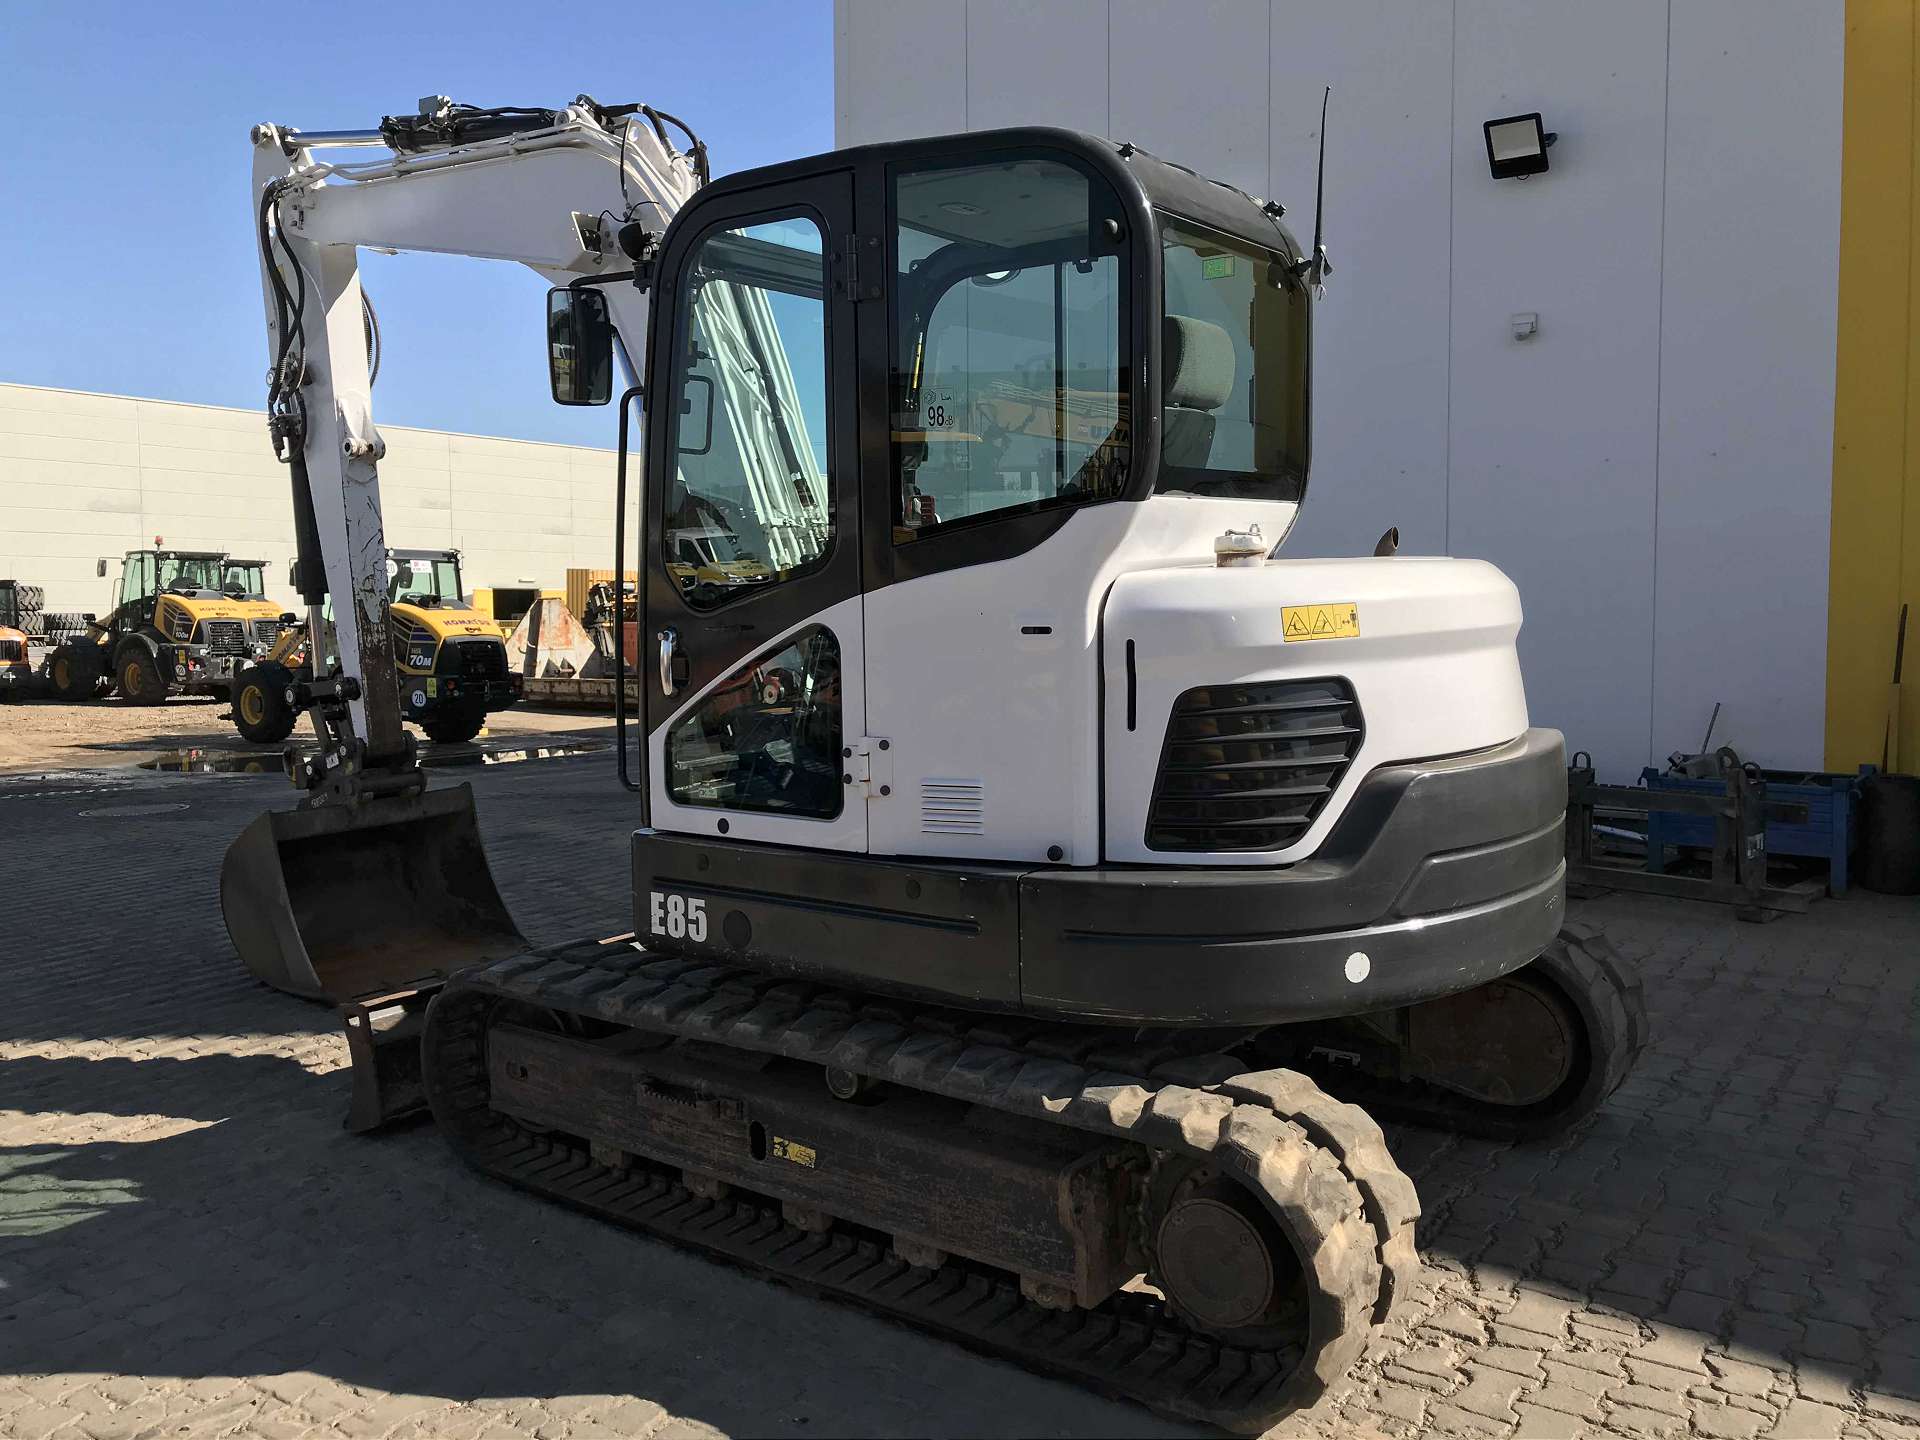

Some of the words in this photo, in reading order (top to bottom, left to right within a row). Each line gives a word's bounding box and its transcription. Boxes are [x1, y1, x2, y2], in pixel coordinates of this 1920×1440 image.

[928, 405, 944, 427] 98
[443, 618, 491, 627] KOMATSU
[409, 654, 432, 666] 70M
[414, 693, 424, 705] 20
[650, 891, 708, 943] E85
